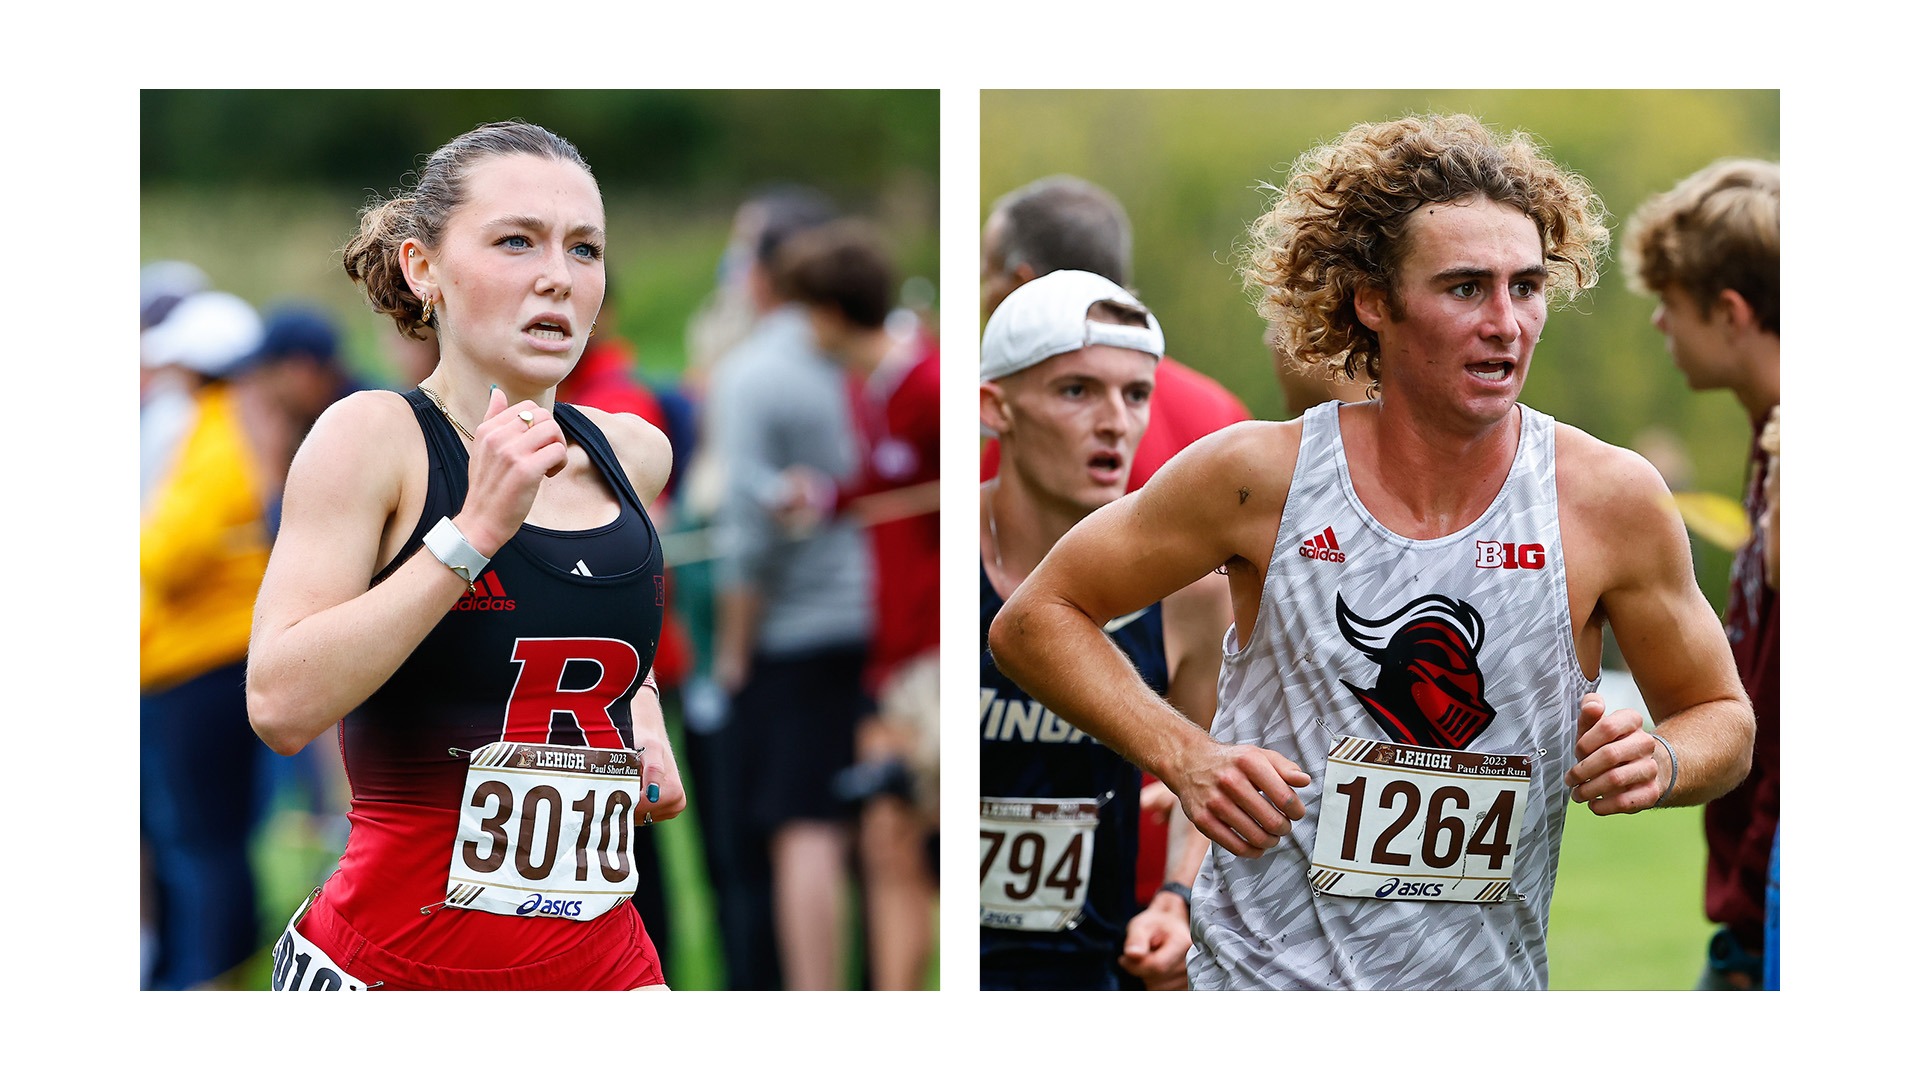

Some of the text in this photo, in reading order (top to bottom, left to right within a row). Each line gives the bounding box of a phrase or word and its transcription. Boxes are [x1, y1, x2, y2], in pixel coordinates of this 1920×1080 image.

[1299, 545, 1346, 563] adidas
[501, 637, 640, 749] R
[536, 750, 586, 770] LEHIGH
[609, 753, 627, 764] 2023
[1394, 748, 1452, 769] LEHIGH
[1482, 756, 1507, 766] 2023
[590, 764, 638, 775] Paul Short Run
[1456, 764, 1527, 776] Paul Short Run
[462, 780, 632, 883] 3010
[1336, 776, 1516, 870] 1264
[1397, 882, 1444, 897] asics
